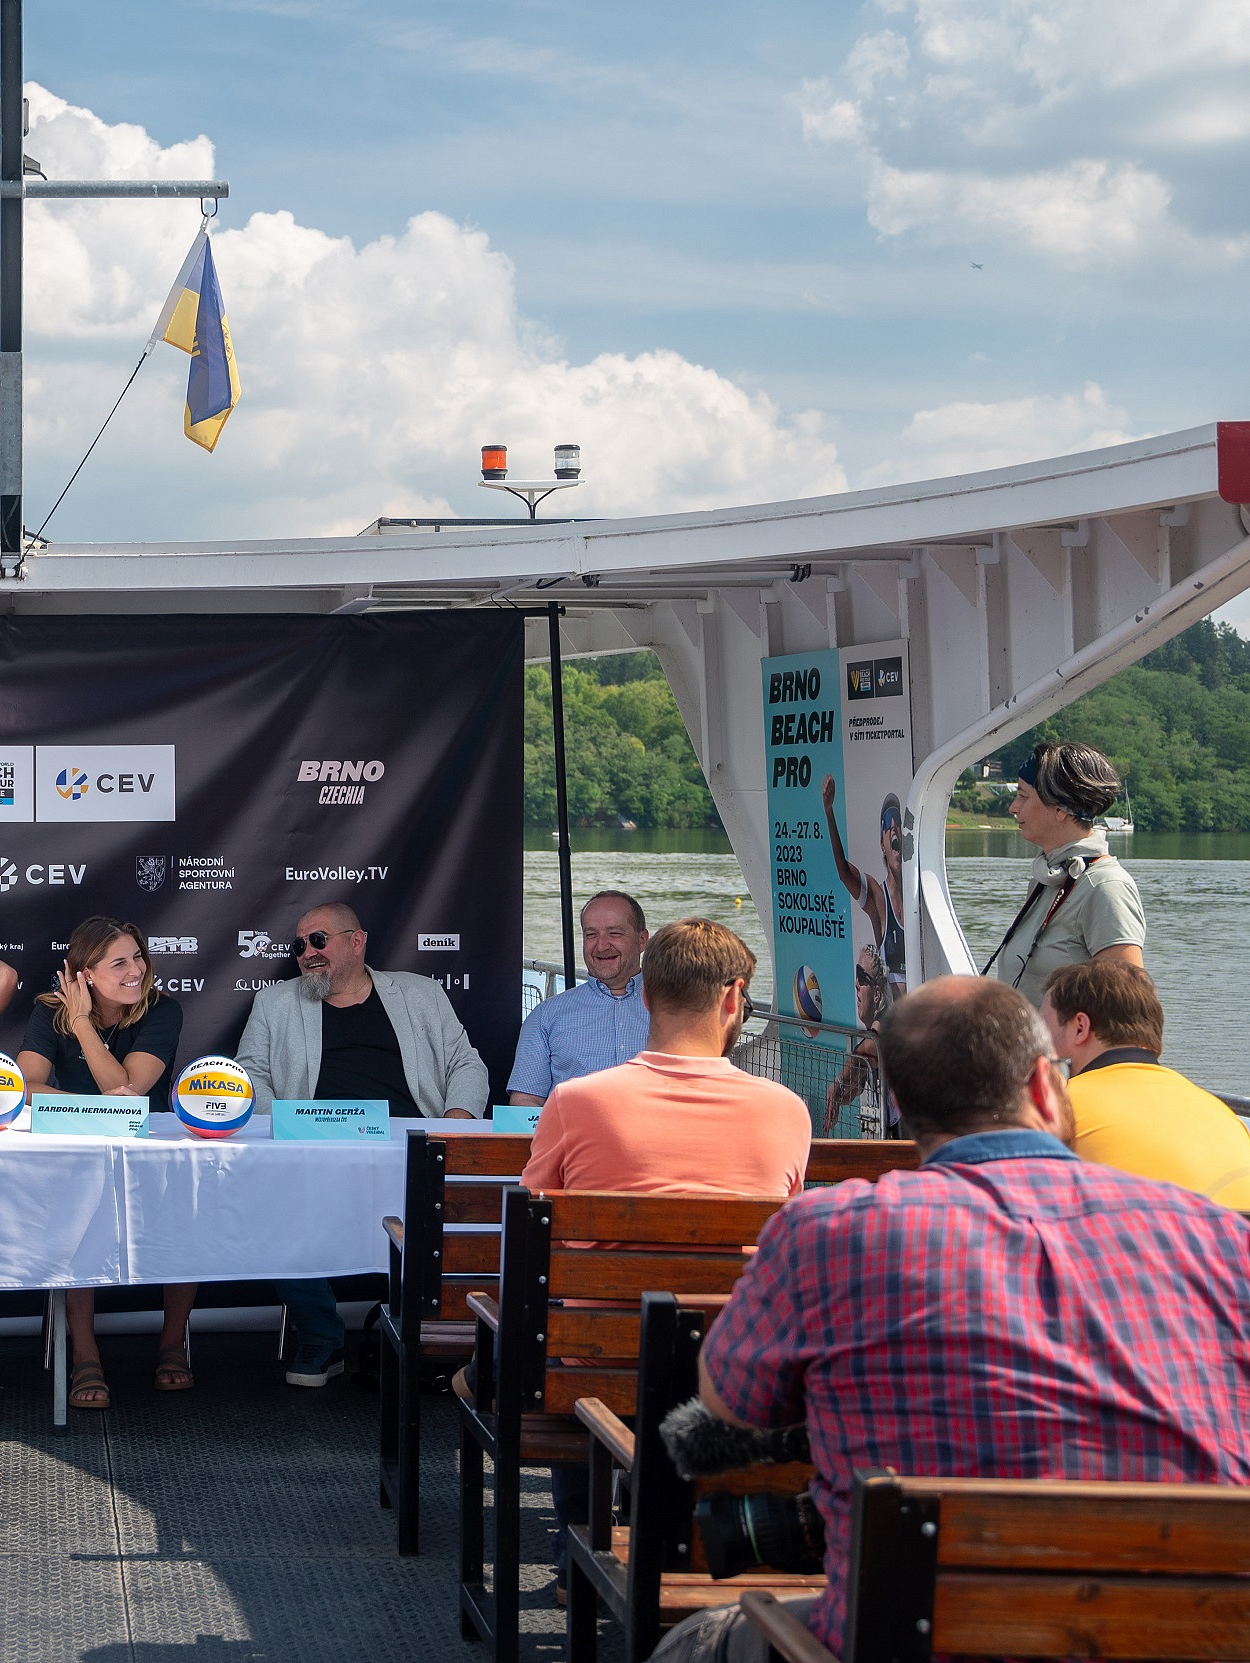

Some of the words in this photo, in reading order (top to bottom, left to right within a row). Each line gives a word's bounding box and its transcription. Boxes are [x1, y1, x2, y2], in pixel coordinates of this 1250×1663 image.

[886, 671, 899, 682] CEV
[769, 667, 821, 704] BRNO
[770, 710, 835, 746] BEACH
[848, 715, 884, 728] PŘEDPRODEJ
[849, 731, 854, 741] V
[854, 729, 865, 741] SÍTI
[865, 728, 905, 741] TICKETPORTAL
[296, 760, 386, 782] BRNO
[772, 755, 812, 788] PRO
[96, 773, 156, 793] CEV
[318, 785, 366, 805] CZECHIA
[814, 822, 824, 840] 8.
[178, 855, 225, 867] NÁRODNÍ
[776, 845, 803, 863] 2023
[25, 864, 87, 885] CEV
[178, 867, 235, 878] SPORTOVNÍ
[285, 866, 389, 884] EuroVolley.TV
[776, 868, 807, 887] BRNO
[178, 881, 233, 890] AGENTURA
[778, 890, 836, 914] SOKOLSKÉ
[779, 915, 846, 939] KOUPALIŠTĚ
[9, 943, 24, 951] kraj
[271, 943, 291, 951] CEV
[423, 937, 456, 947] deník
[261, 951, 291, 959] Together
[167, 978, 205, 992] CEV
[190, 1060, 223, 1072] BEACH
[225, 1062, 244, 1074] PRO
[37, 1105, 80, 1114] BARBORA
[81, 1107, 143, 1116] HERMANNOVÁ
[205, 1101, 227, 1110] FIVB
